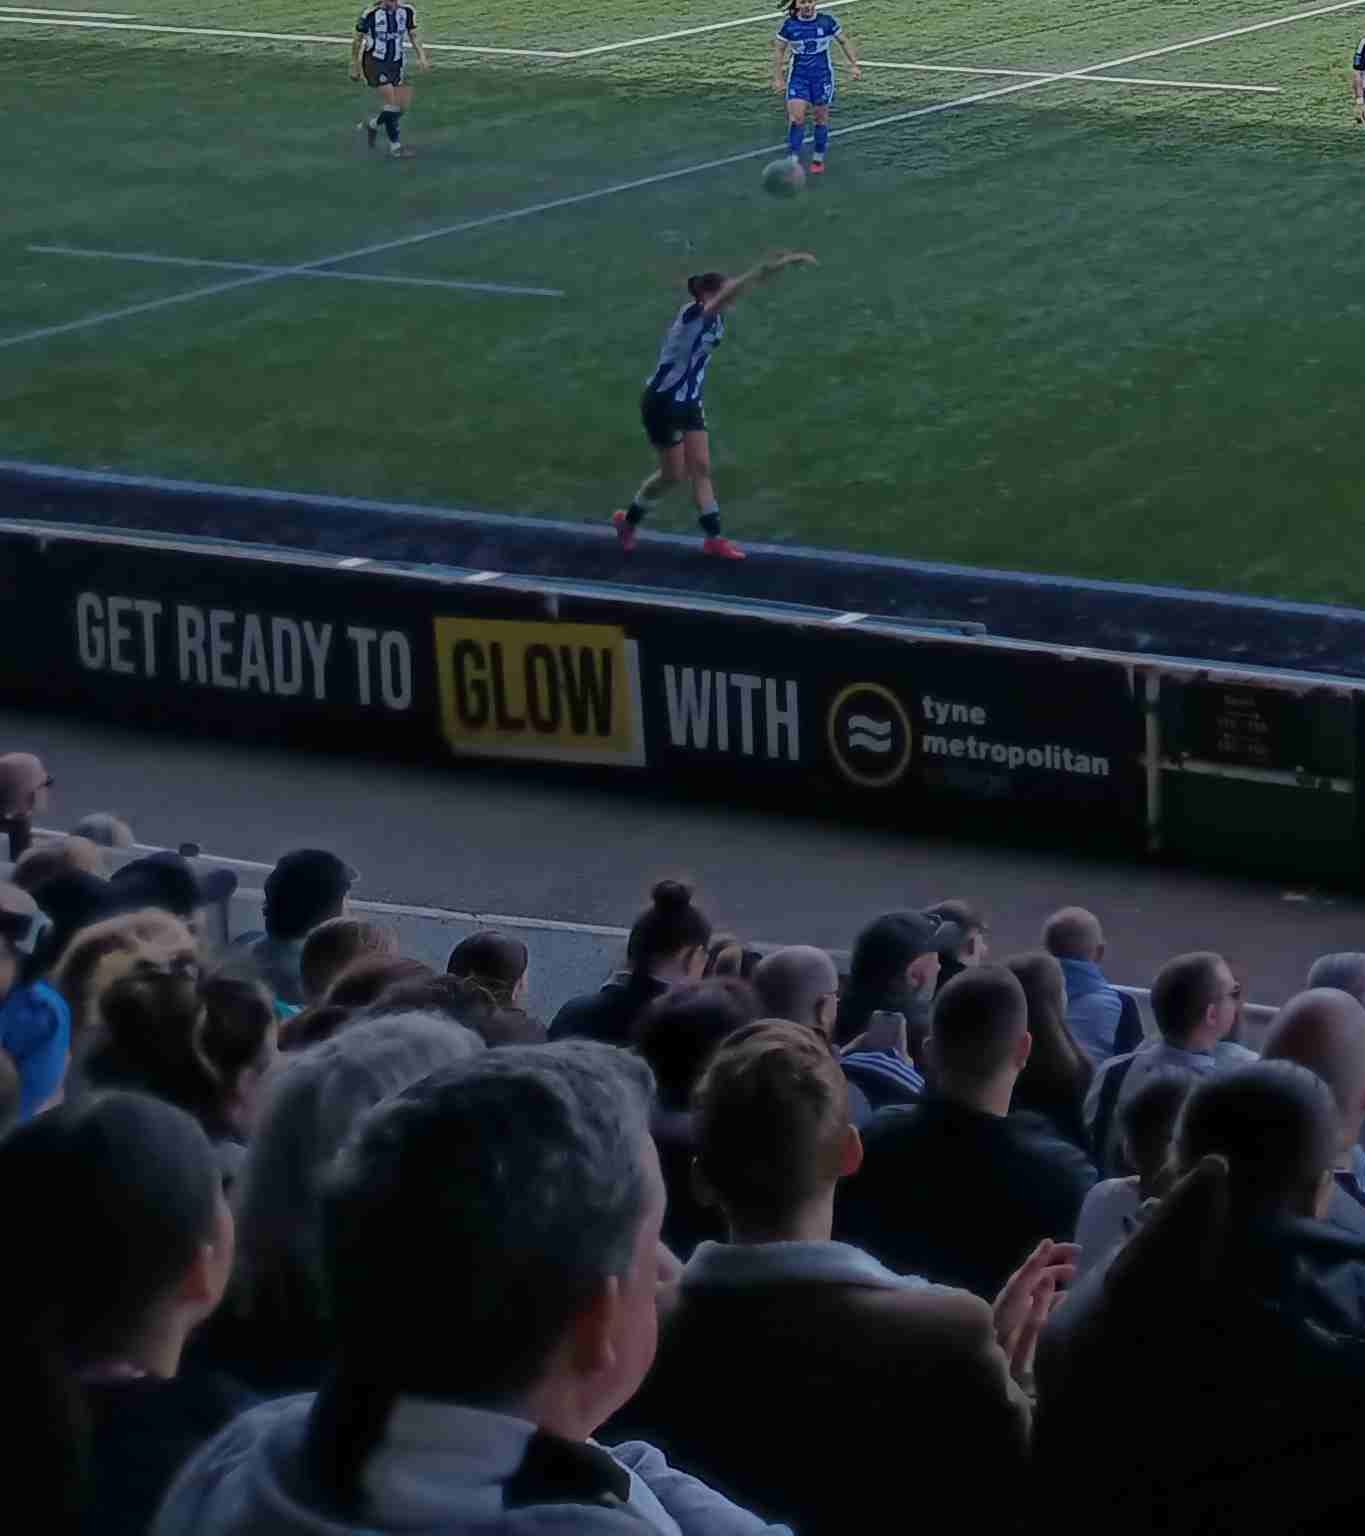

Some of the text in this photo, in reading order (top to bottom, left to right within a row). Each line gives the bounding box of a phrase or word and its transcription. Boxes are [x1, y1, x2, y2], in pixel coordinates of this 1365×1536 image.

[75, 591, 800, 762] GET READY TO GLOW WITH
[921, 694, 987, 728] tyne
[921, 729, 1110, 777] metropolitan
